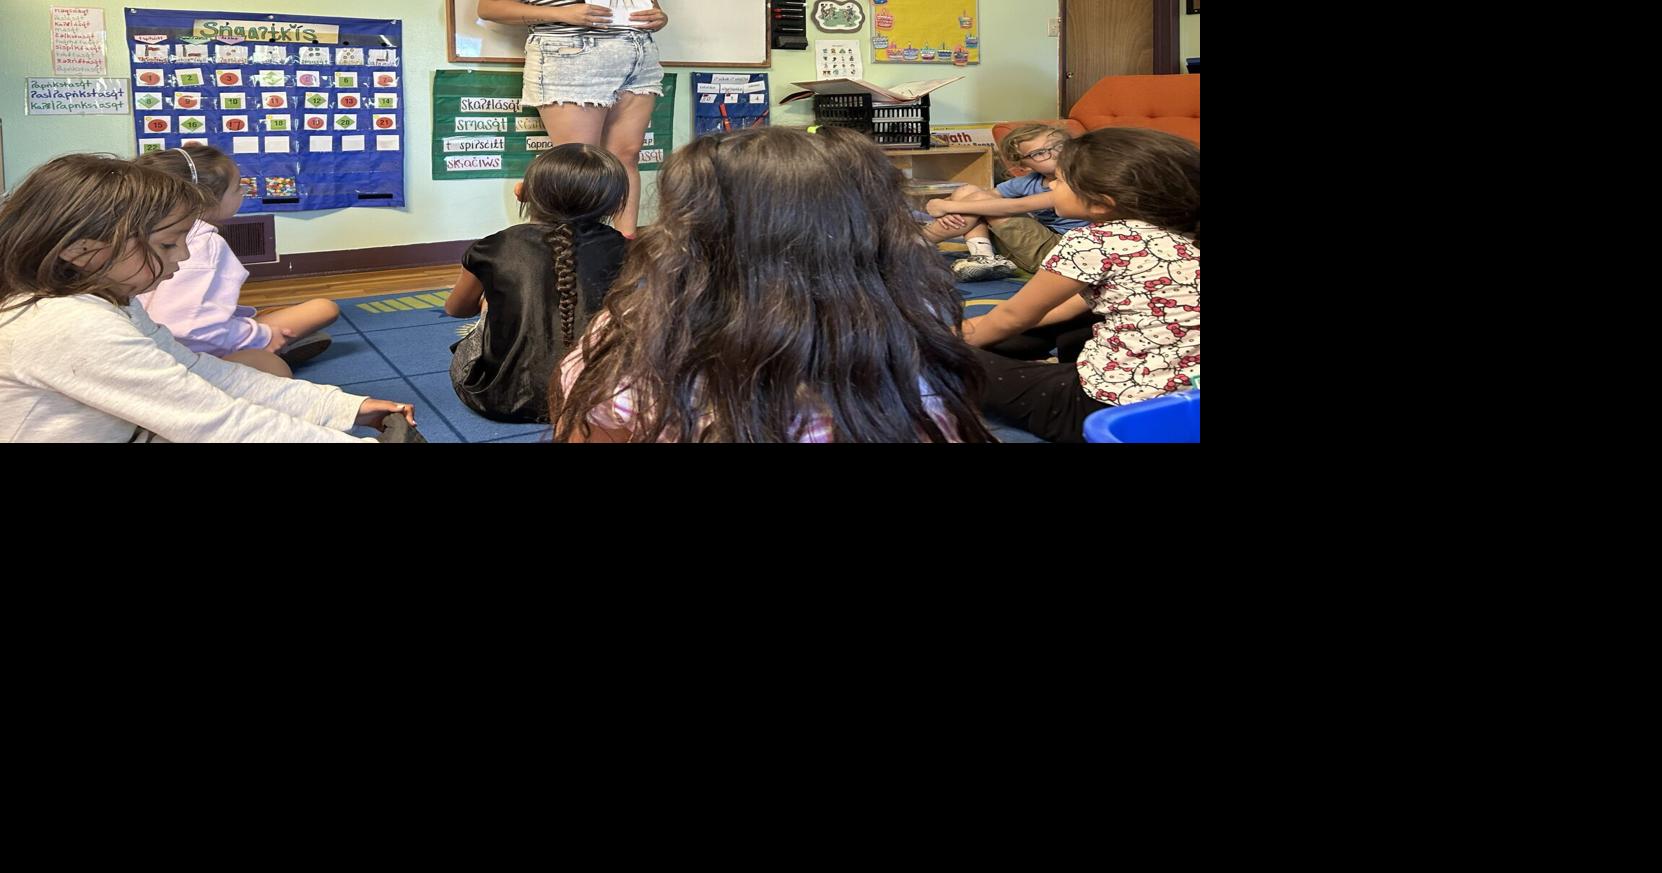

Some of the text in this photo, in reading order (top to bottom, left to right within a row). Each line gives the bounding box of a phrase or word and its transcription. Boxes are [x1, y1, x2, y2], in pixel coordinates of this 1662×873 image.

[188, 121, 198, 129] 16
[229, 121, 241, 130] 17
[340, 119, 350, 127] 20
[379, 119, 390, 127] 21
